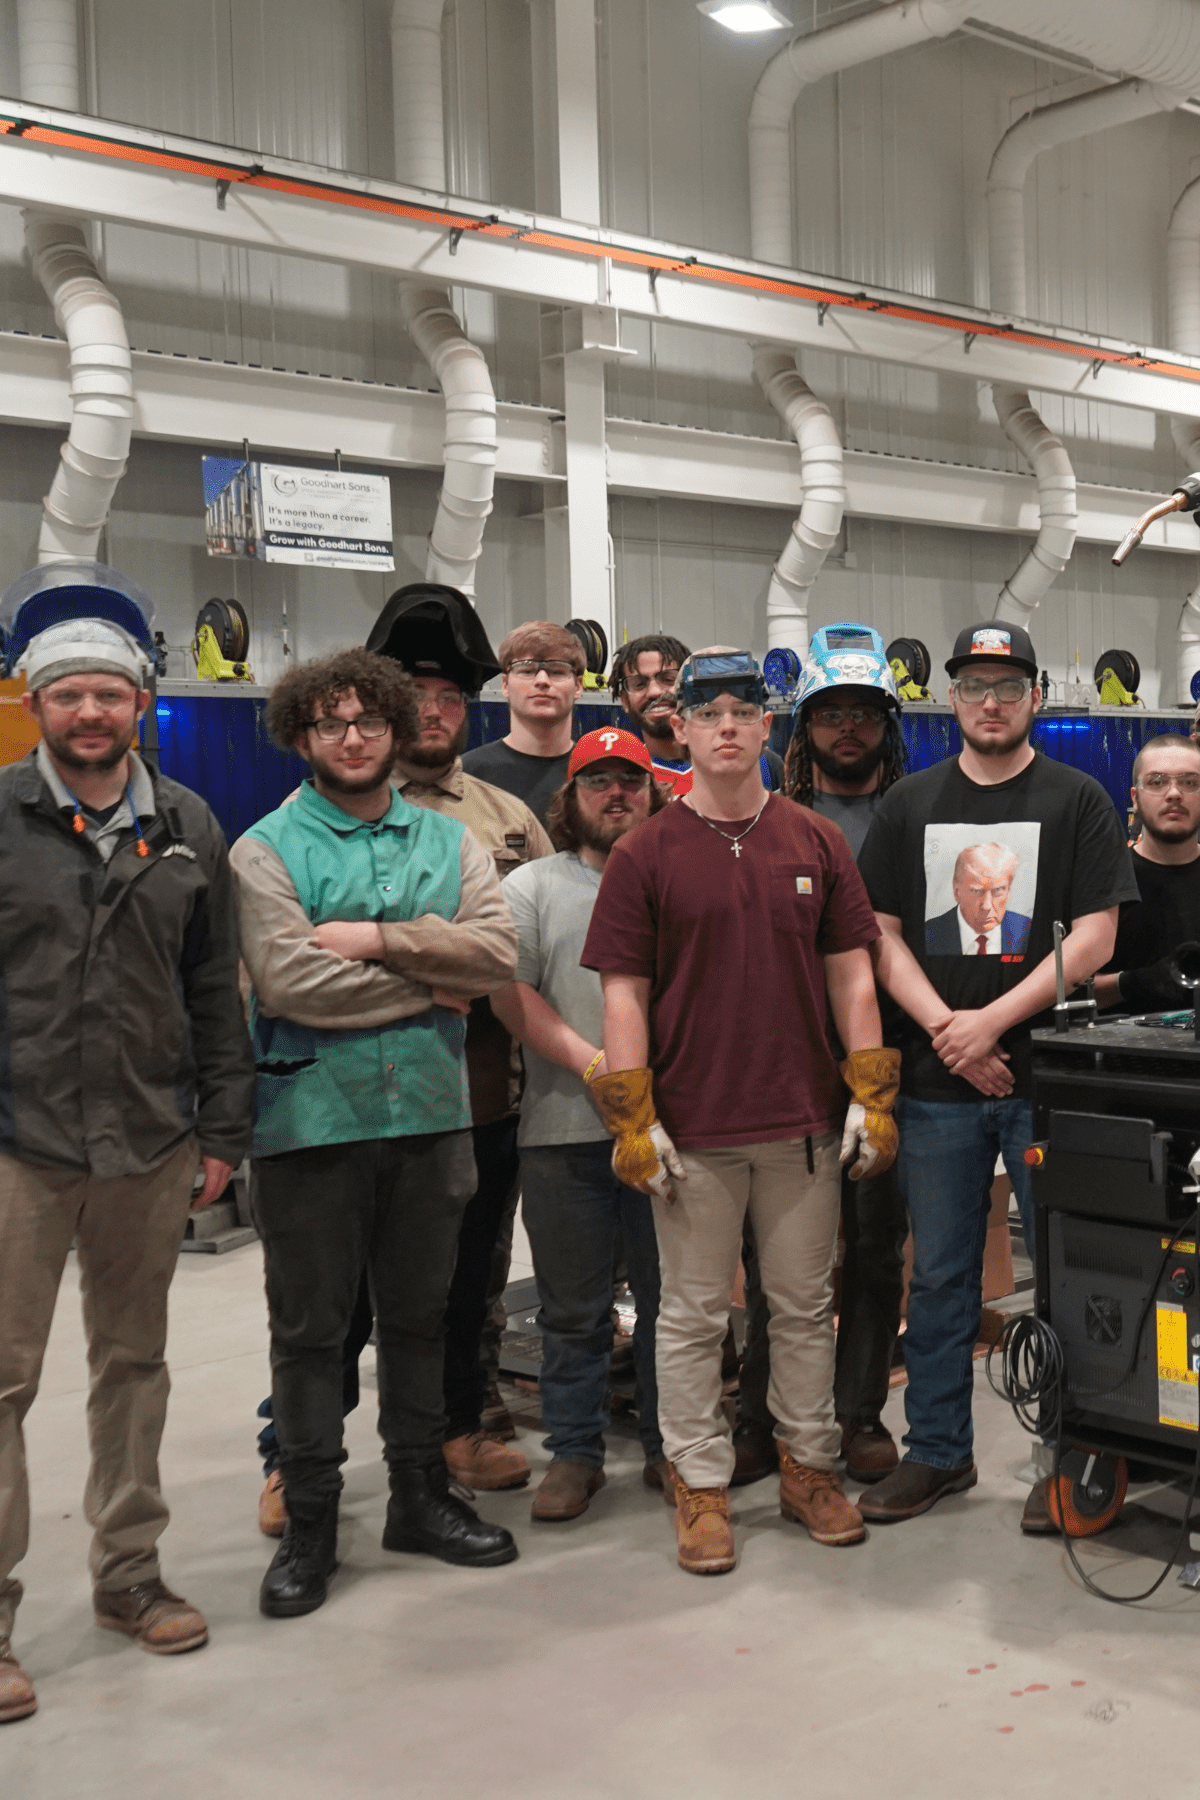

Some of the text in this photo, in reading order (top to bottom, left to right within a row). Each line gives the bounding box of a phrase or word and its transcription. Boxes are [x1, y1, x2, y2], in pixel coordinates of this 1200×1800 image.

[301, 477, 346, 490] Goodhart
[348, 482, 371, 493] Sons
[268, 505, 281, 514] It's
[284, 508, 307, 517] more
[310, 510, 331, 519] than
[340, 514, 371, 524] career.
[269, 517, 325, 532] It's a legacy.
[269, 534, 390, 554] Grow with Goodhart Sons.
[598, 732, 619, 751] P
